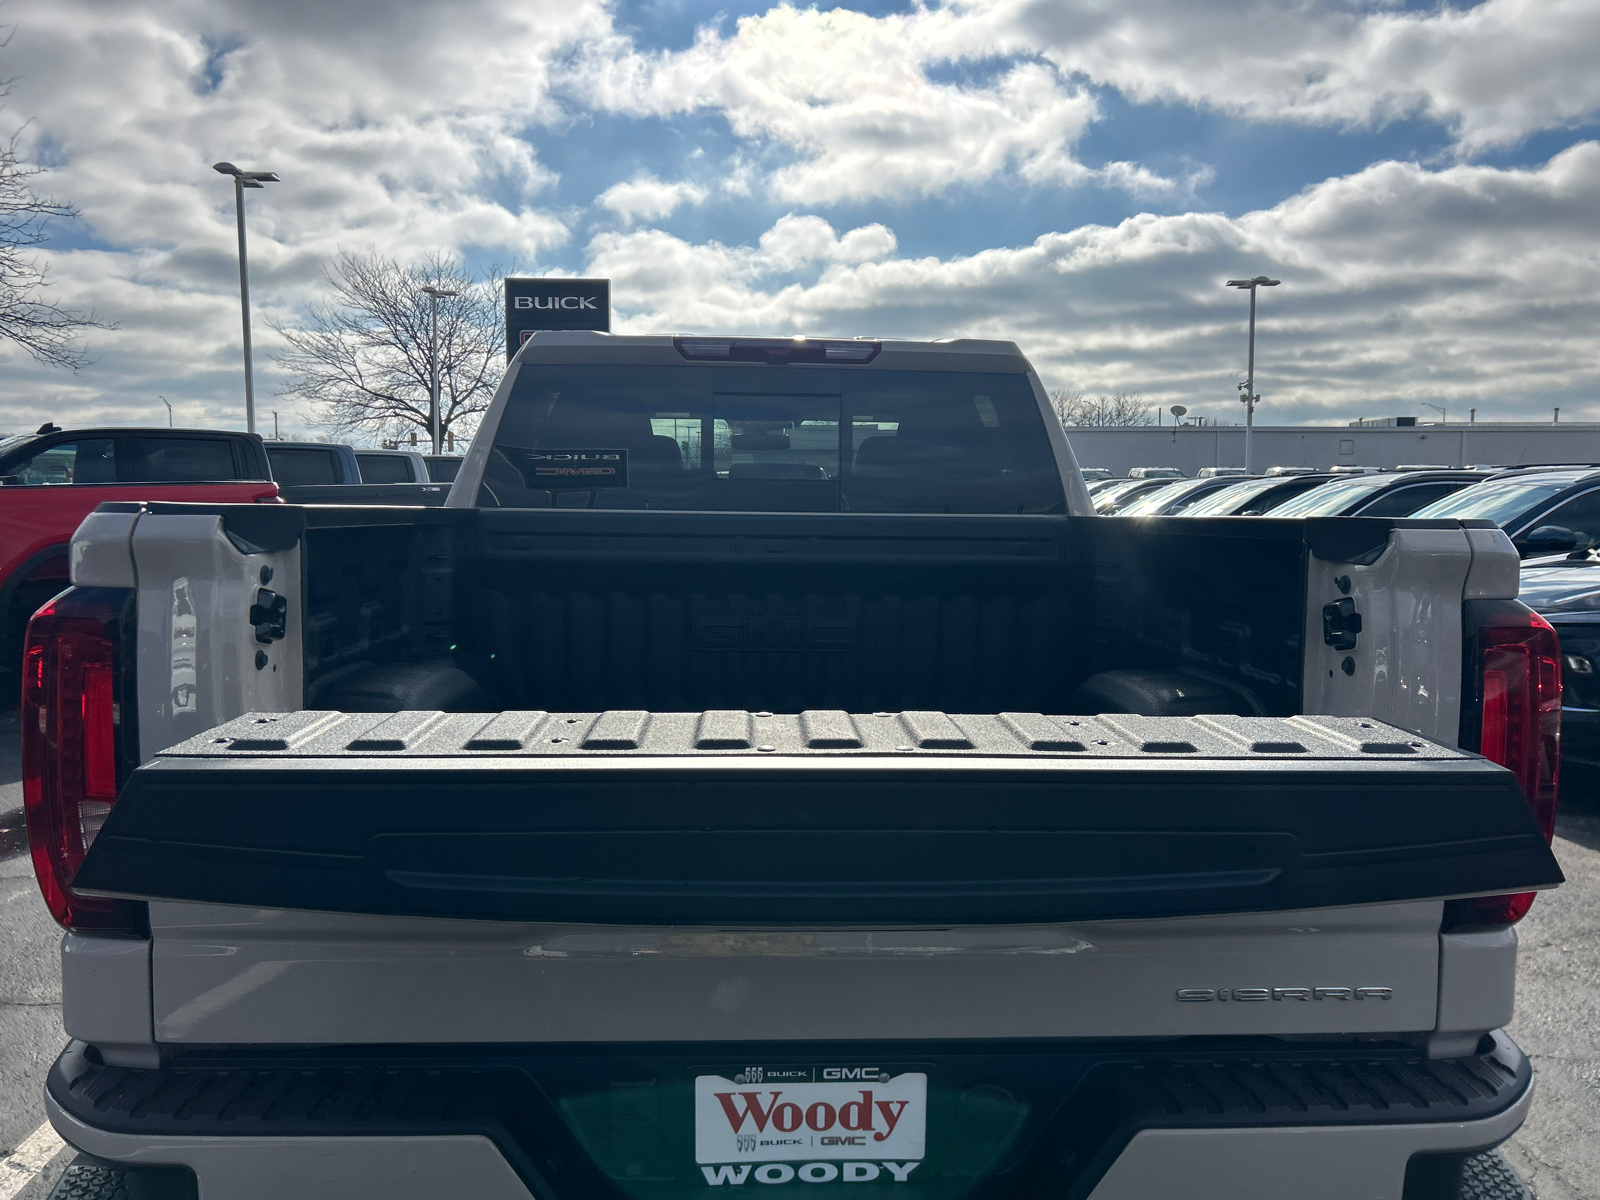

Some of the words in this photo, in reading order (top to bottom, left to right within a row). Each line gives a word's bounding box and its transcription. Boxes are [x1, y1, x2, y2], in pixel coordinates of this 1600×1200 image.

[514, 296, 598, 310] BUICK
[688, 615, 855, 652] GMC
[1175, 986, 1394, 1002] SIERRA
[767, 1070, 808, 1078] BUICK
[822, 1067, 880, 1080] GMC
[713, 1090, 909, 1142] Woody
[759, 1138, 803, 1147] BUICK
[820, 1136, 867, 1147] GMC
[700, 1162, 921, 1186] WOODY
